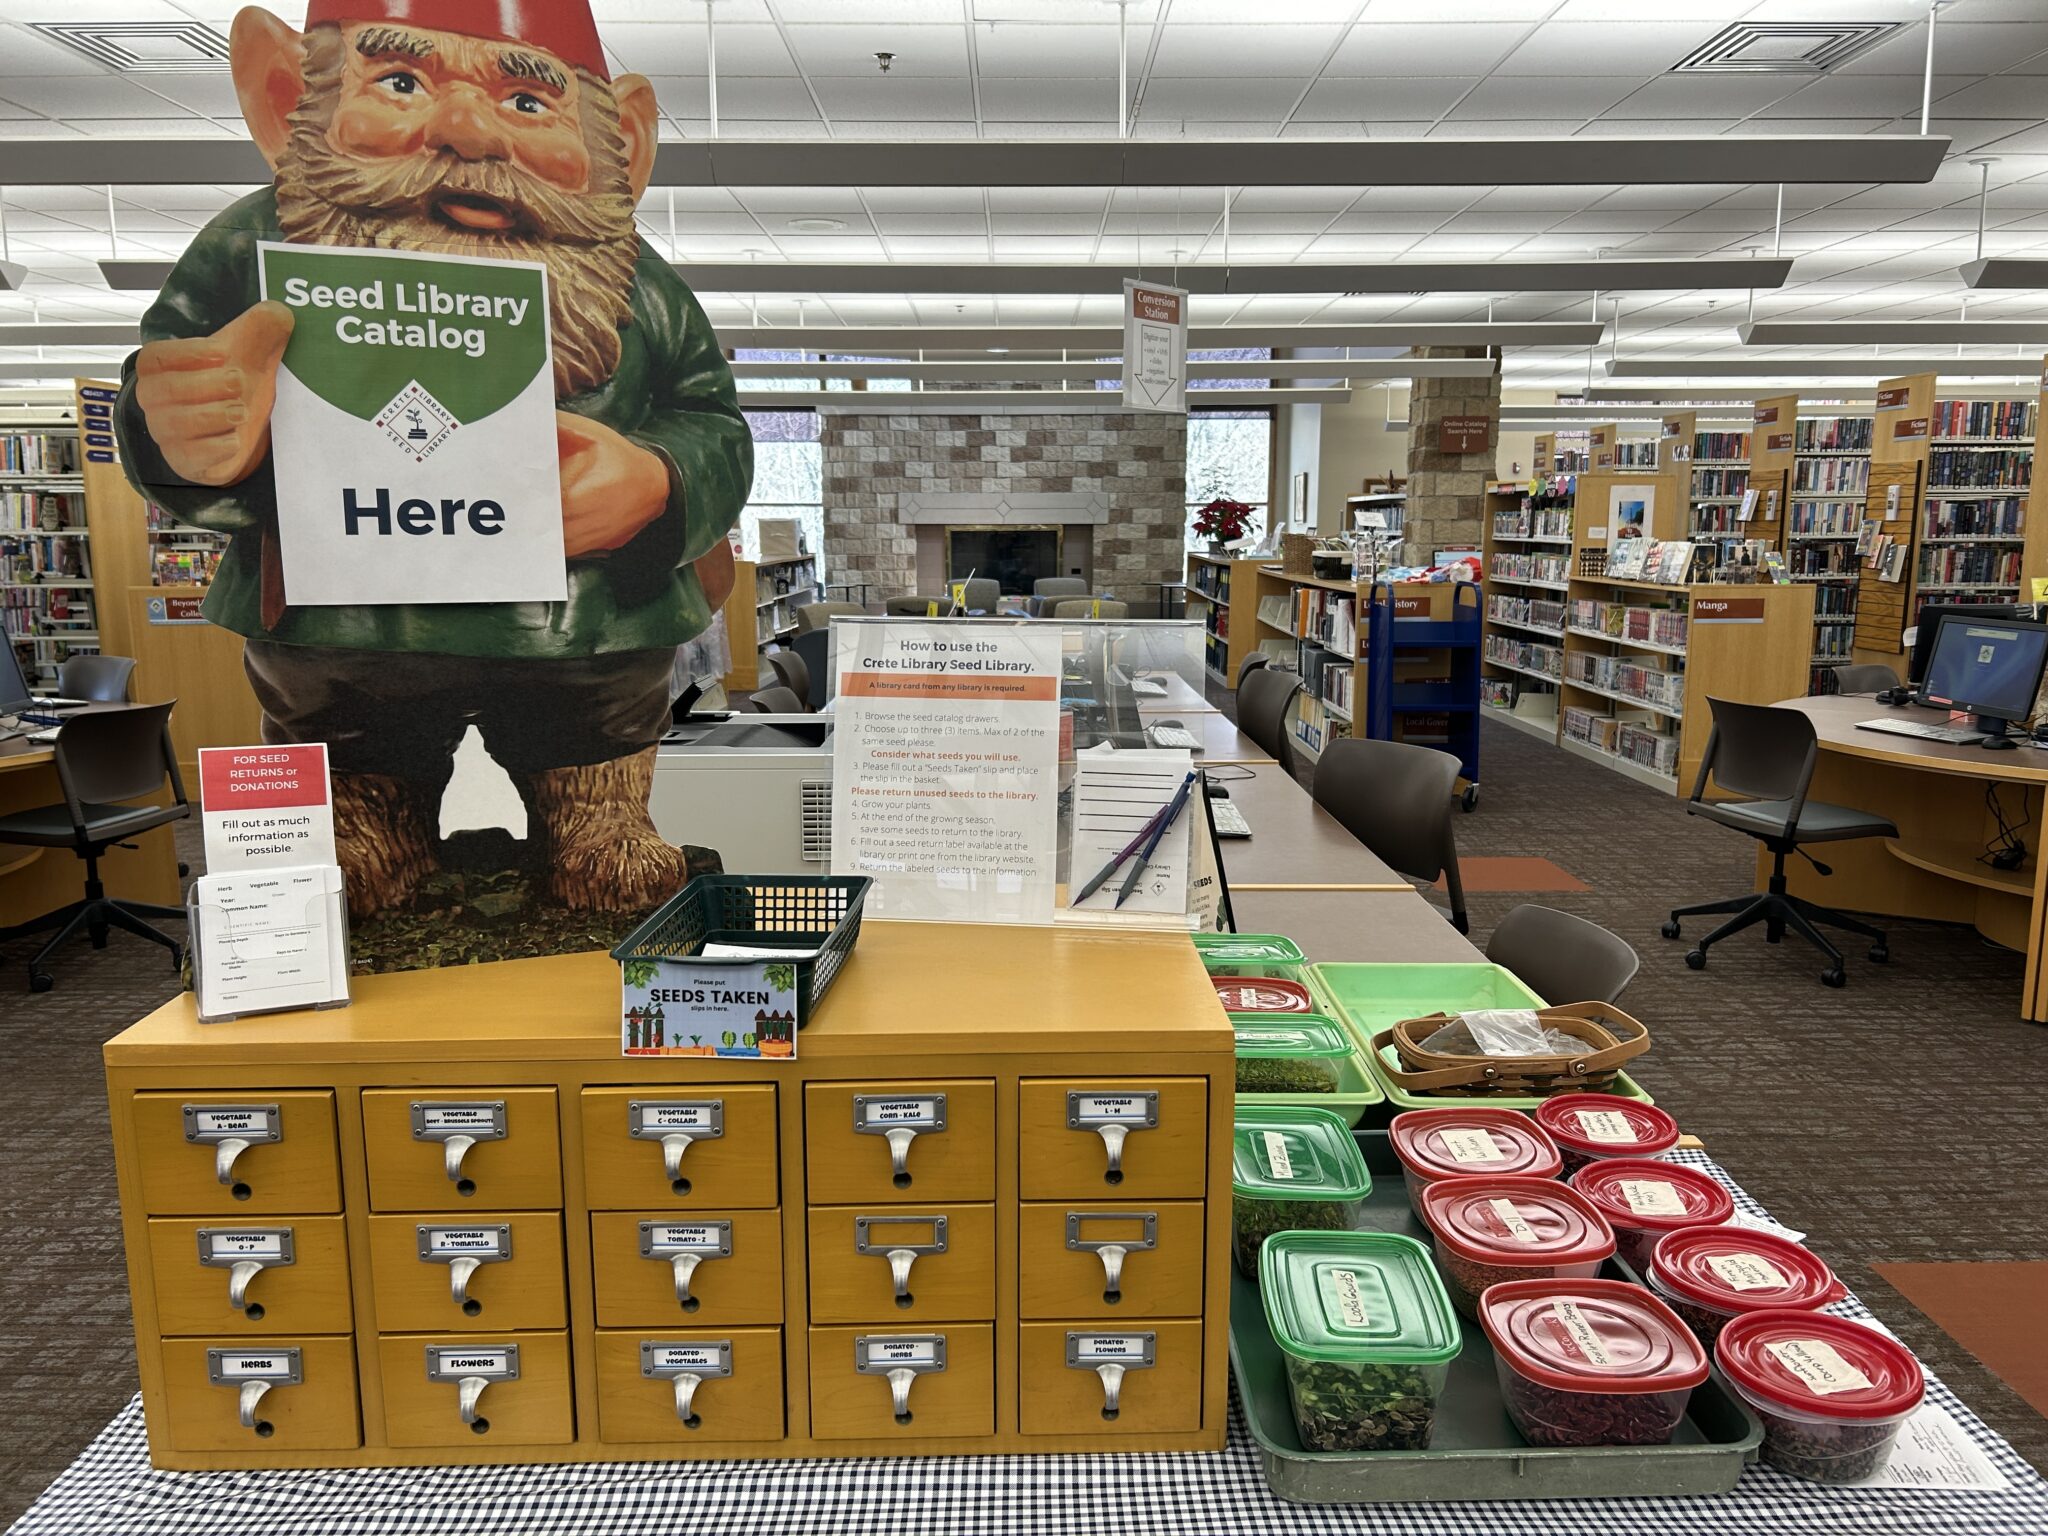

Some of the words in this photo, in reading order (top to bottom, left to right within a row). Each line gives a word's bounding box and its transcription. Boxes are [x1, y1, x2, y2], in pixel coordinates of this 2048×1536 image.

[284, 277, 385, 310] Seed
[395, 282, 530, 326] Library
[1137, 291, 1176, 309] Conversion
[1144, 306, 1169, 320] Station
[336, 316, 487, 358] Catalog
[382, 391, 412, 420] CRETE
[419, 391, 452, 422] LIBRARY
[386, 430, 412, 455] SEED
[422, 429, 452, 459] LIBRARY
[342, 487, 505, 535] Here
[172, 599, 200, 609] Beyond
[1393, 598, 1418, 611] istory
[1696, 600, 1728, 612] Manga
[180, 610, 203, 618] Colle
[900, 640, 930, 652] How
[933, 641, 947, 652] to
[950, 642, 973, 652] use
[976, 641, 998, 653] the
[863, 658, 898, 669] Crete
[901, 658, 947, 672] Library
[949, 659, 982, 671] Seed
[985, 660, 1035, 673] Library.
[876, 682, 901, 690] library
[903, 682, 921, 690] card
[957, 683, 982, 692] library
[865, 712, 895, 721] Browse
[897, 712, 910, 721] the
[912, 713, 932, 722] seed
[934, 714, 964, 724] catalog
[233, 755, 257, 765] FOR
[259, 754, 290, 764] SEED
[871, 750, 910, 759] Consider
[912, 751, 935, 760] what
[937, 751, 963, 760] seeds
[965, 753, 982, 762] you
[984, 753, 1000, 761] will
[230, 768, 284, 779] RETURNS
[286, 768, 298, 776] or
[862, 762, 889, 771] Please
[890, 762, 900, 771] fill
[901, 764, 915, 772] out
[983, 764, 997, 775] slip
[999, 765, 1015, 774] and
[1016, 765, 1038, 775] place
[230, 780, 299, 792] DONATIONS
[851, 787, 880, 796] Please
[882, 788, 911, 797] return
[913, 789, 947, 798] unused
[949, 790, 975, 799] seeds
[976, 791, 986, 799] to
[988, 791, 1003, 799] the
[1005, 791, 1038, 801] library.
[222, 820, 239, 830] Fill
[241, 819, 261, 828] out
[263, 819, 276, 827] as
[278, 816, 310, 826] much
[228, 831, 295, 843] information
[297, 831, 309, 839] as
[245, 844, 294, 857] possible.
[249, 880, 279, 889] Vegetable
[715, 979, 726, 987] put
[650, 988, 705, 1003] SEEDS
[710, 990, 769, 1005] TAKEN
